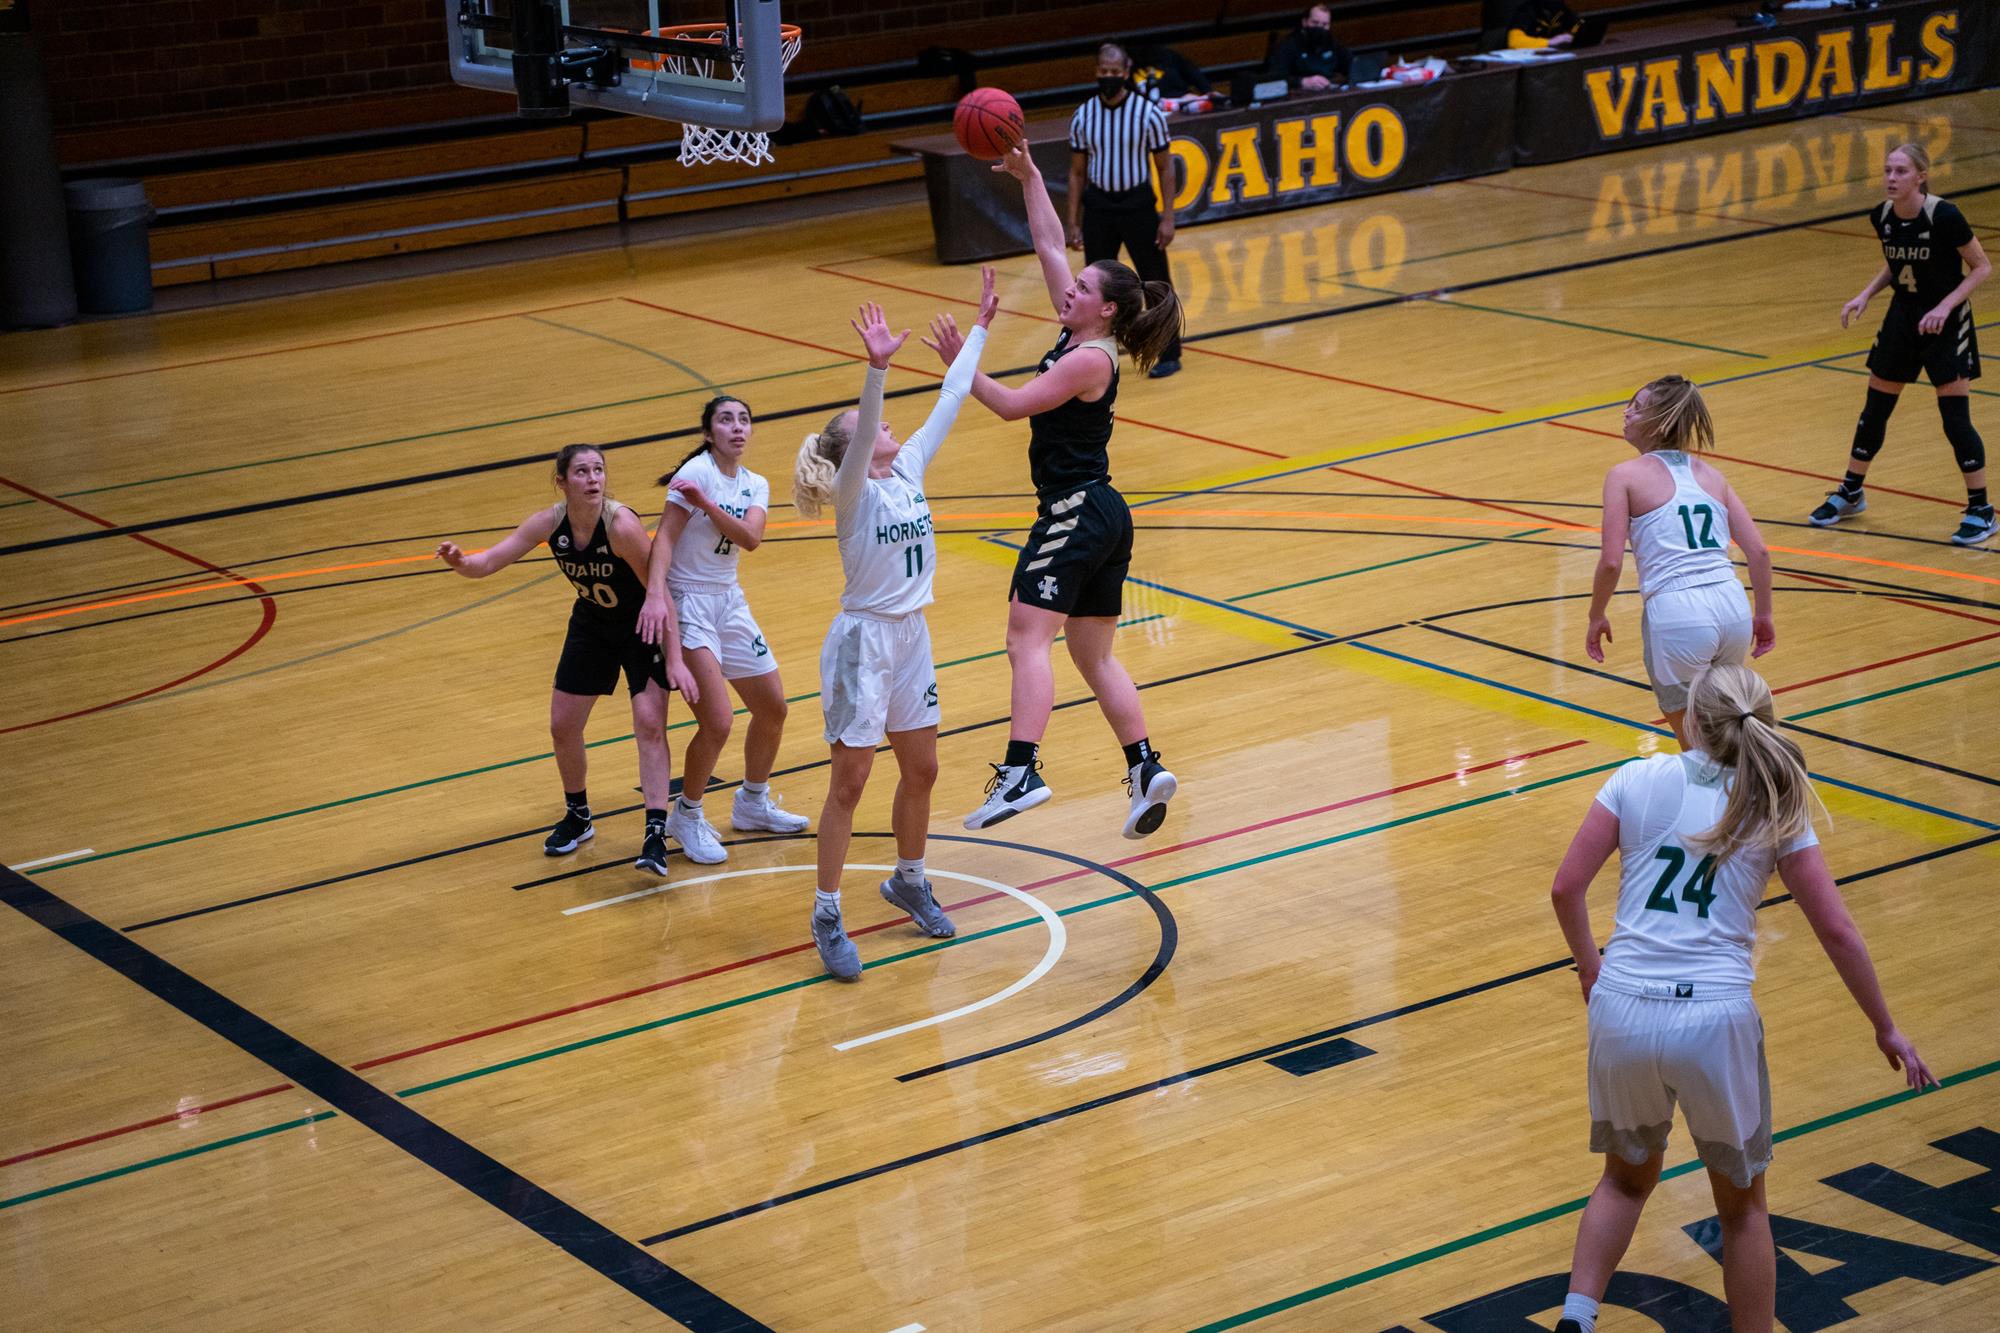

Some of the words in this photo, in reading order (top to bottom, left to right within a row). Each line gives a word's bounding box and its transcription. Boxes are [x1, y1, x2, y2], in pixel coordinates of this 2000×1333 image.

[1584, 11, 1959, 139] VANDALS
[1150, 105, 1407, 213] DAHO
[1884, 245, 1931, 260] IDAHO
[1898, 264, 1918, 293] 4
[1677, 503, 1722, 550] 12
[904, 543, 924, 578] 11
[1644, 845, 1718, 919] 24
